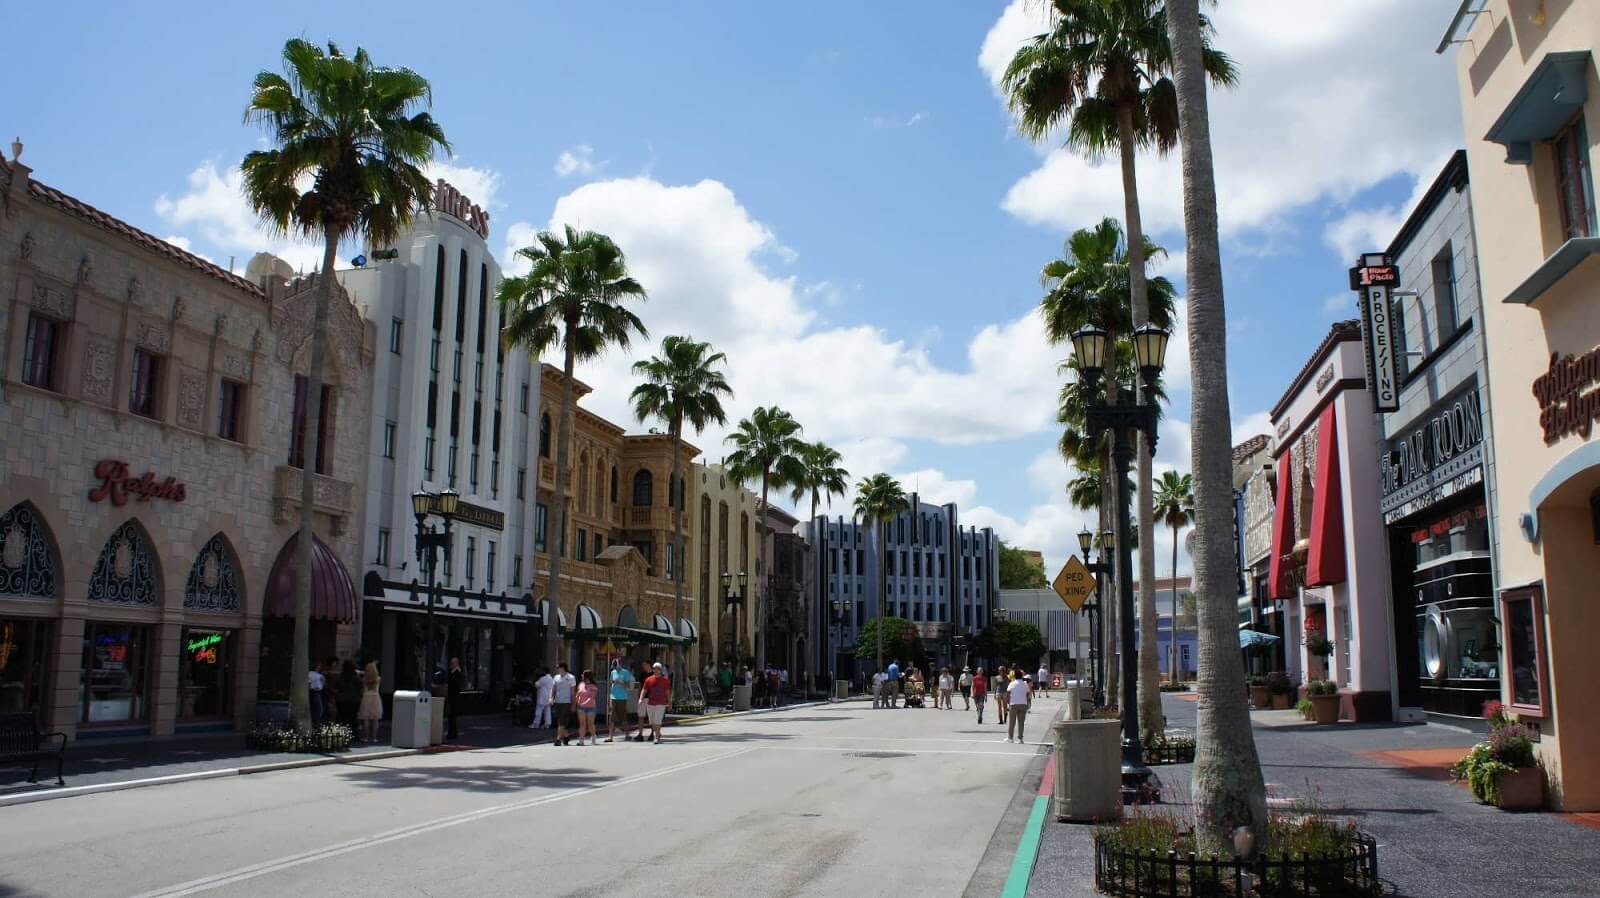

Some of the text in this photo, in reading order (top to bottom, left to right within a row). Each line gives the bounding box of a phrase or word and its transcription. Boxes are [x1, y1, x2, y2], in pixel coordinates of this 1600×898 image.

[1359, 267, 1372, 285] 1
[1369, 273, 1394, 281] Photo
[1372, 291, 1393, 401] PROCESSING
[1382, 451, 1402, 496] The
[1431, 390, 1482, 466] ROOM
[87, 459, 187, 508] Ralphs
[1065, 572, 1084, 582] PED
[1065, 585, 1087, 597] XING
